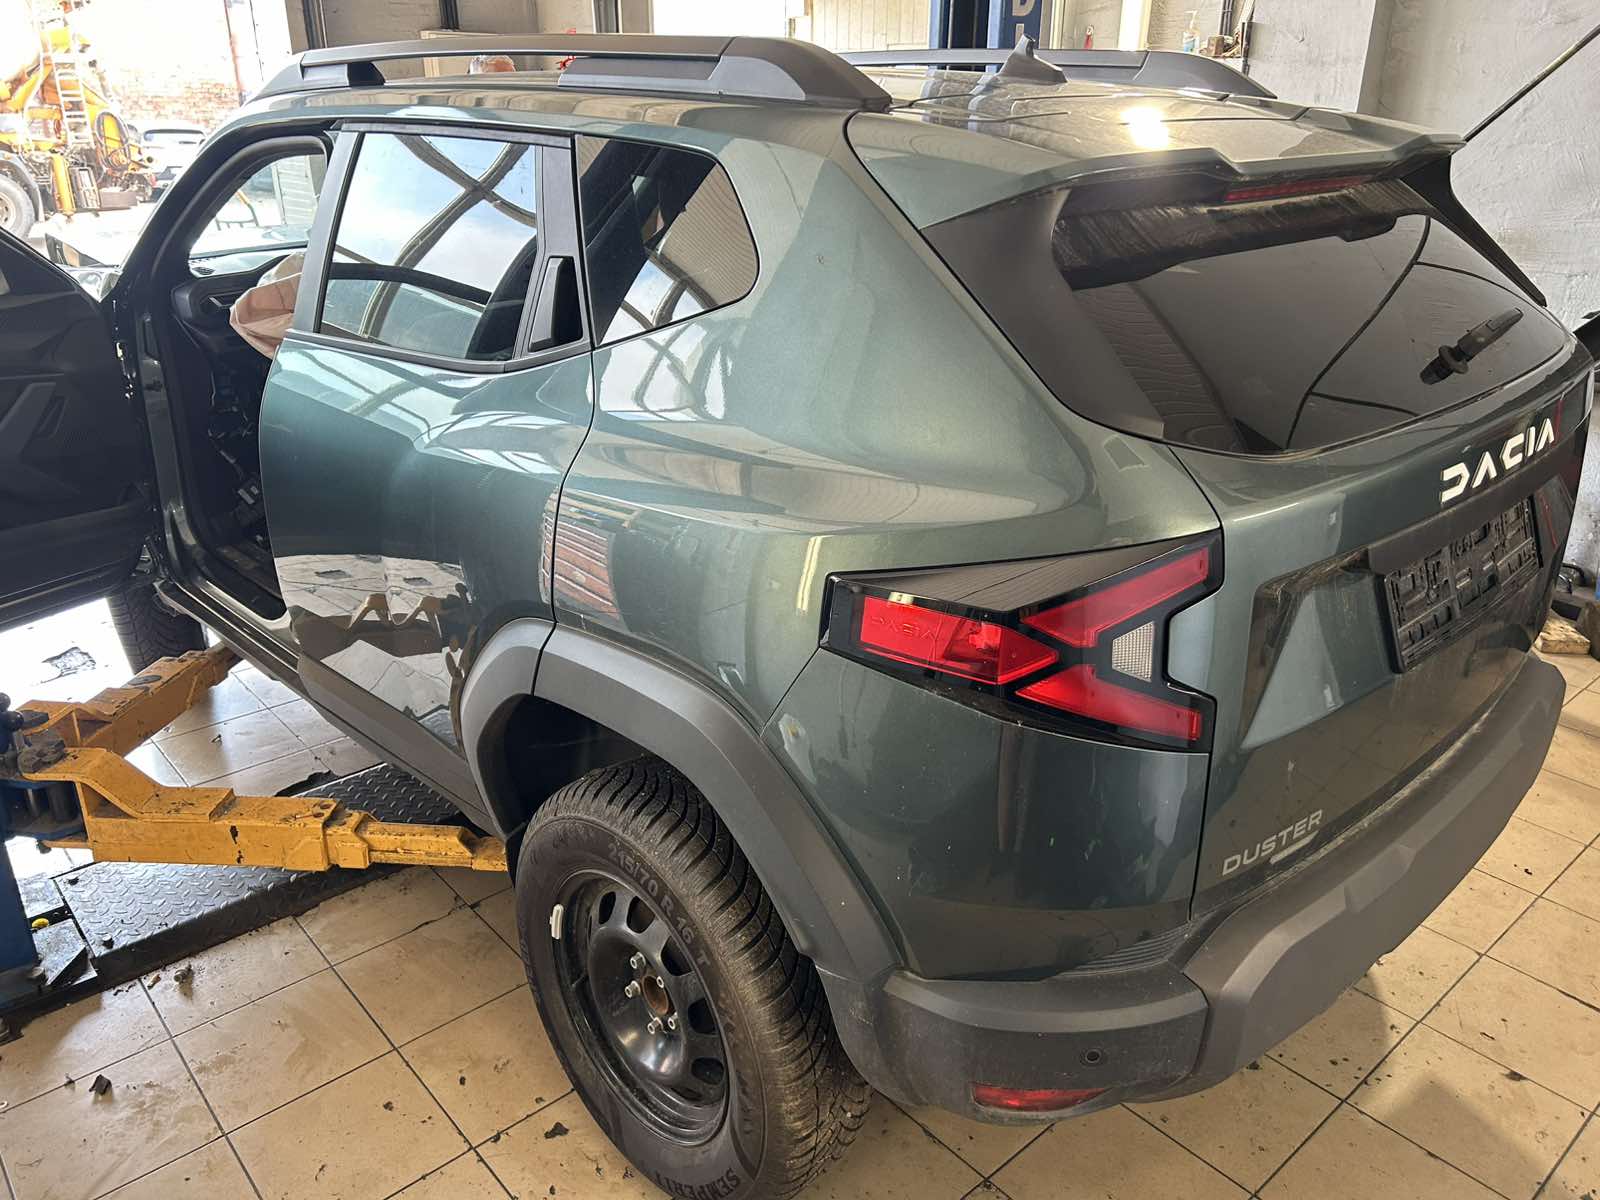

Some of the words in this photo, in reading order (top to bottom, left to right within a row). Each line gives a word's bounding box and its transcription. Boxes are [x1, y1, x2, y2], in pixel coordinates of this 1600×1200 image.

[1440, 418, 1554, 503] DACIA
[608, 843, 659, 897] 215/70
[1222, 810, 1322, 875] DUSTER
